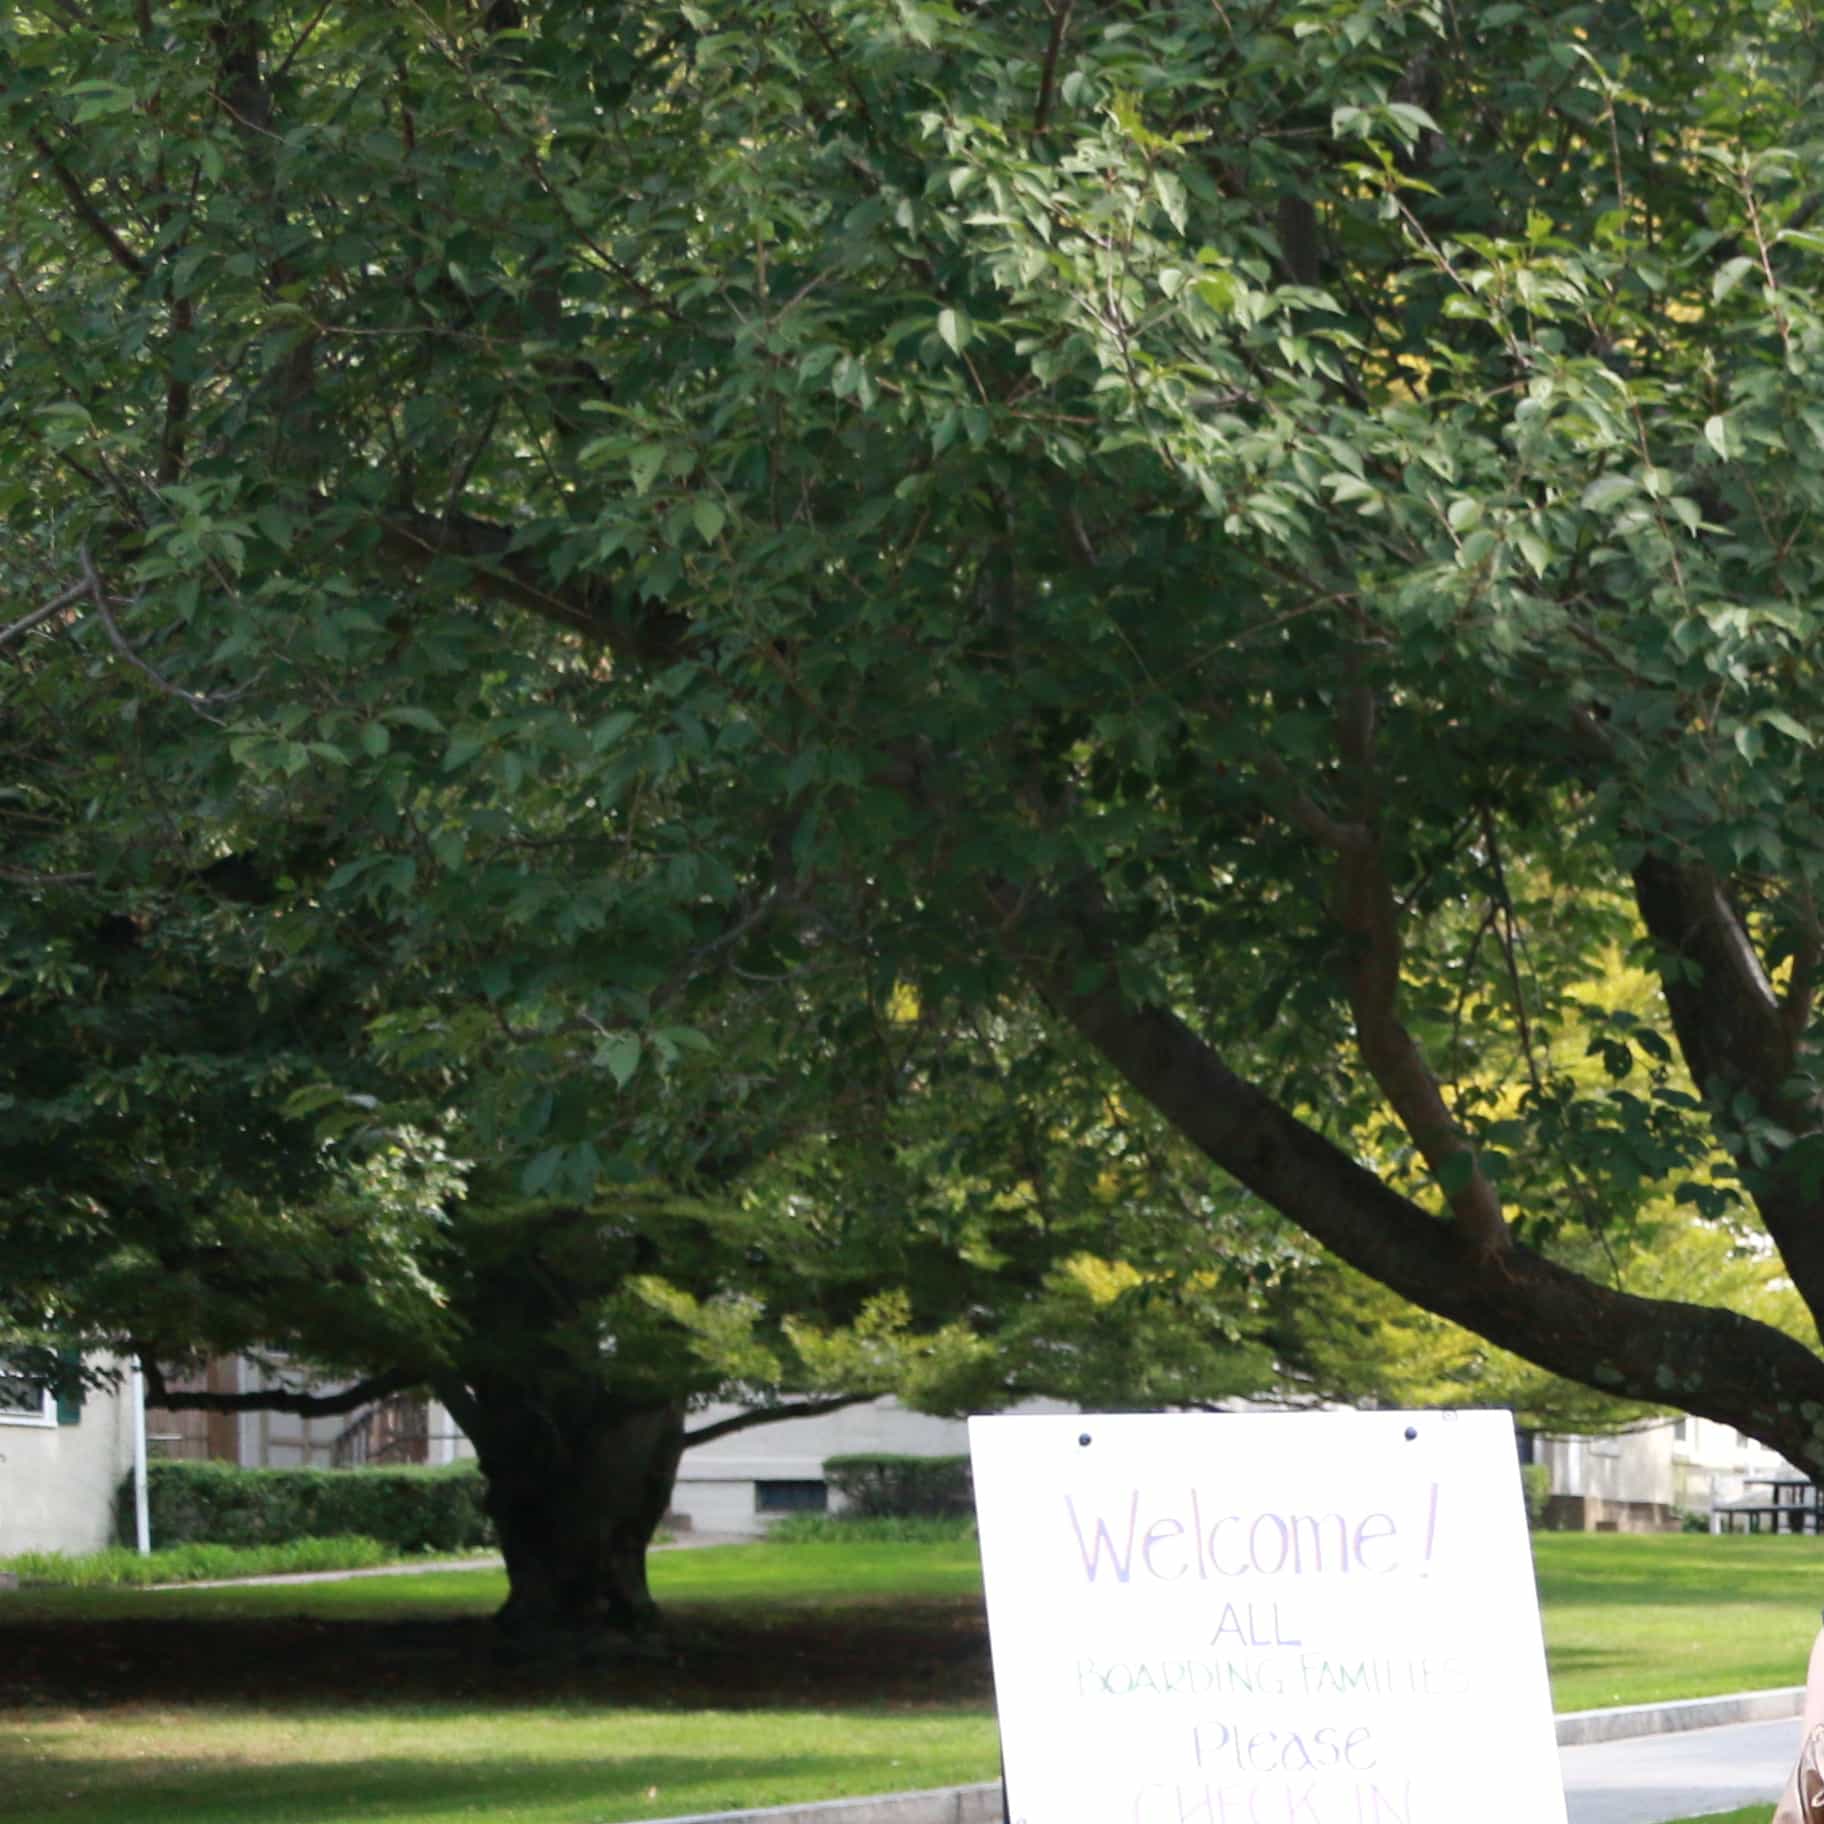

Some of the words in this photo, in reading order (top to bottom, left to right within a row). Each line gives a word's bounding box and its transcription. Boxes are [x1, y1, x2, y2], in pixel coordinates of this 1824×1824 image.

[1209, 1601, 1302, 1647] ALL
[1075, 1656, 1286, 1697] BOARDING
[1192, 1720, 1378, 1772] Please
